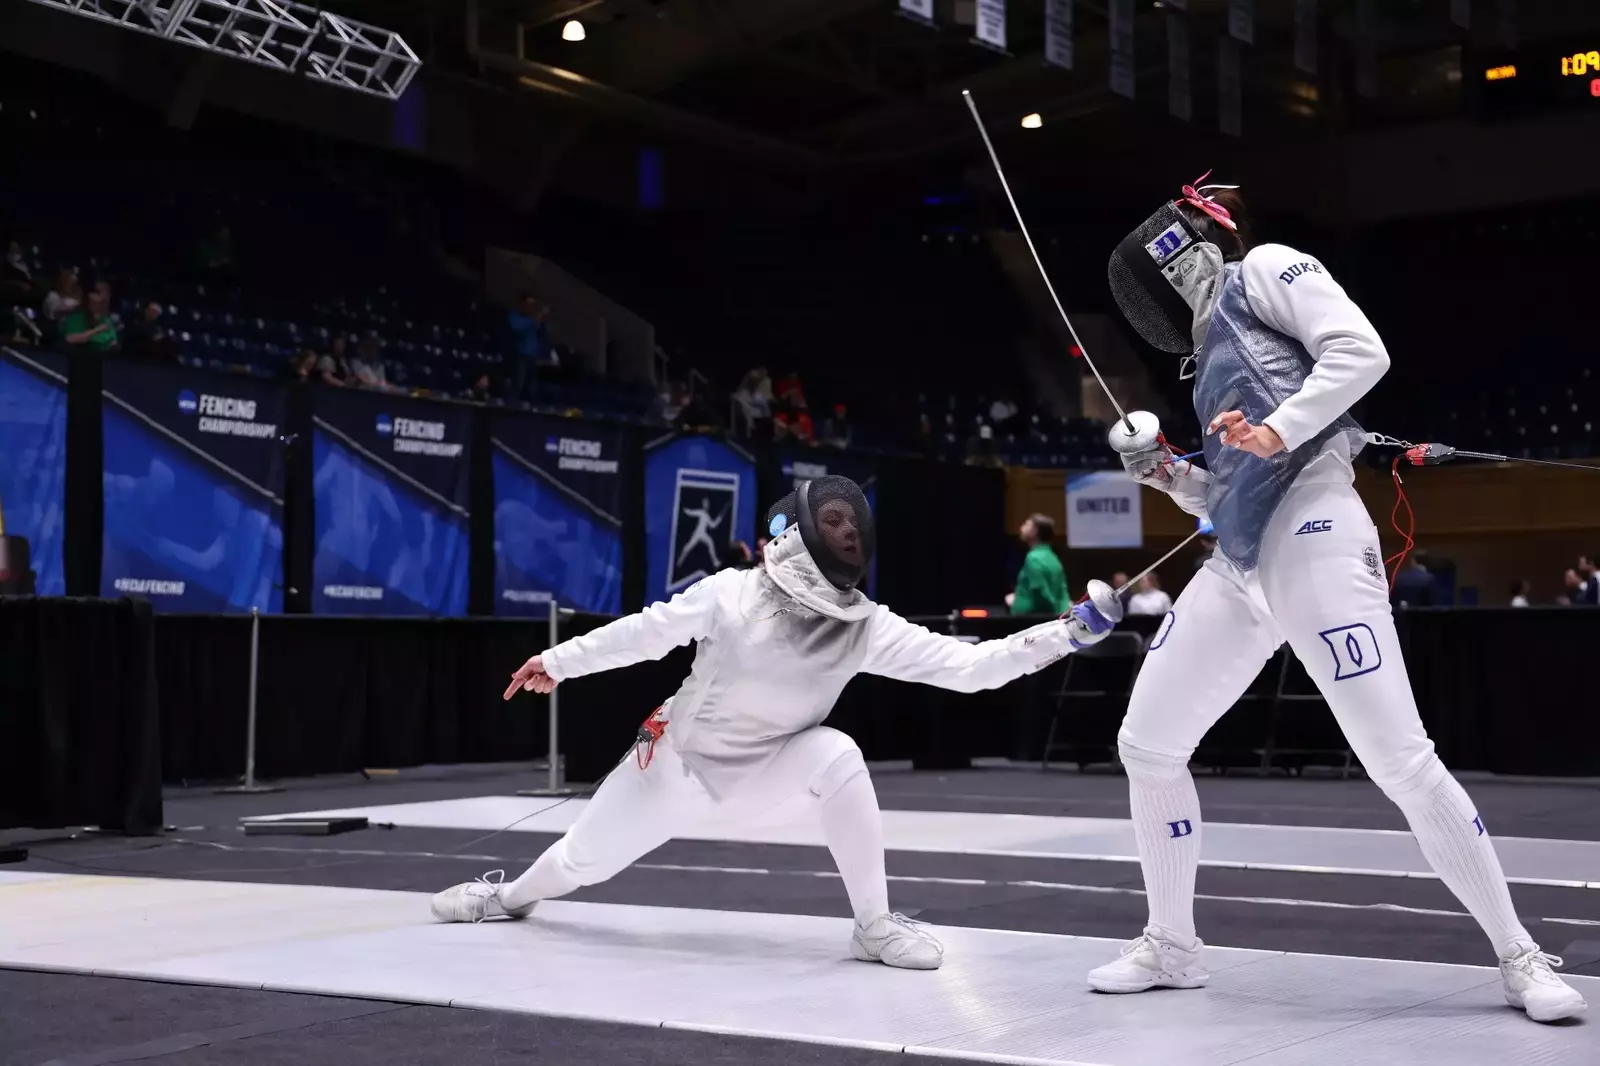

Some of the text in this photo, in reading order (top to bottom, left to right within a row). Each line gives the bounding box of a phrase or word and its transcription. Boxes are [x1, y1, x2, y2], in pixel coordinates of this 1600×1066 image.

[1279, 262, 1322, 285] DUKE
[199, 394, 257, 419] FENCING
[394, 417, 445, 441] FENCING
[1076, 497, 1130, 514] UNITED
[1294, 519, 1333, 535] ACC
[1167, 819, 1192, 838] D
